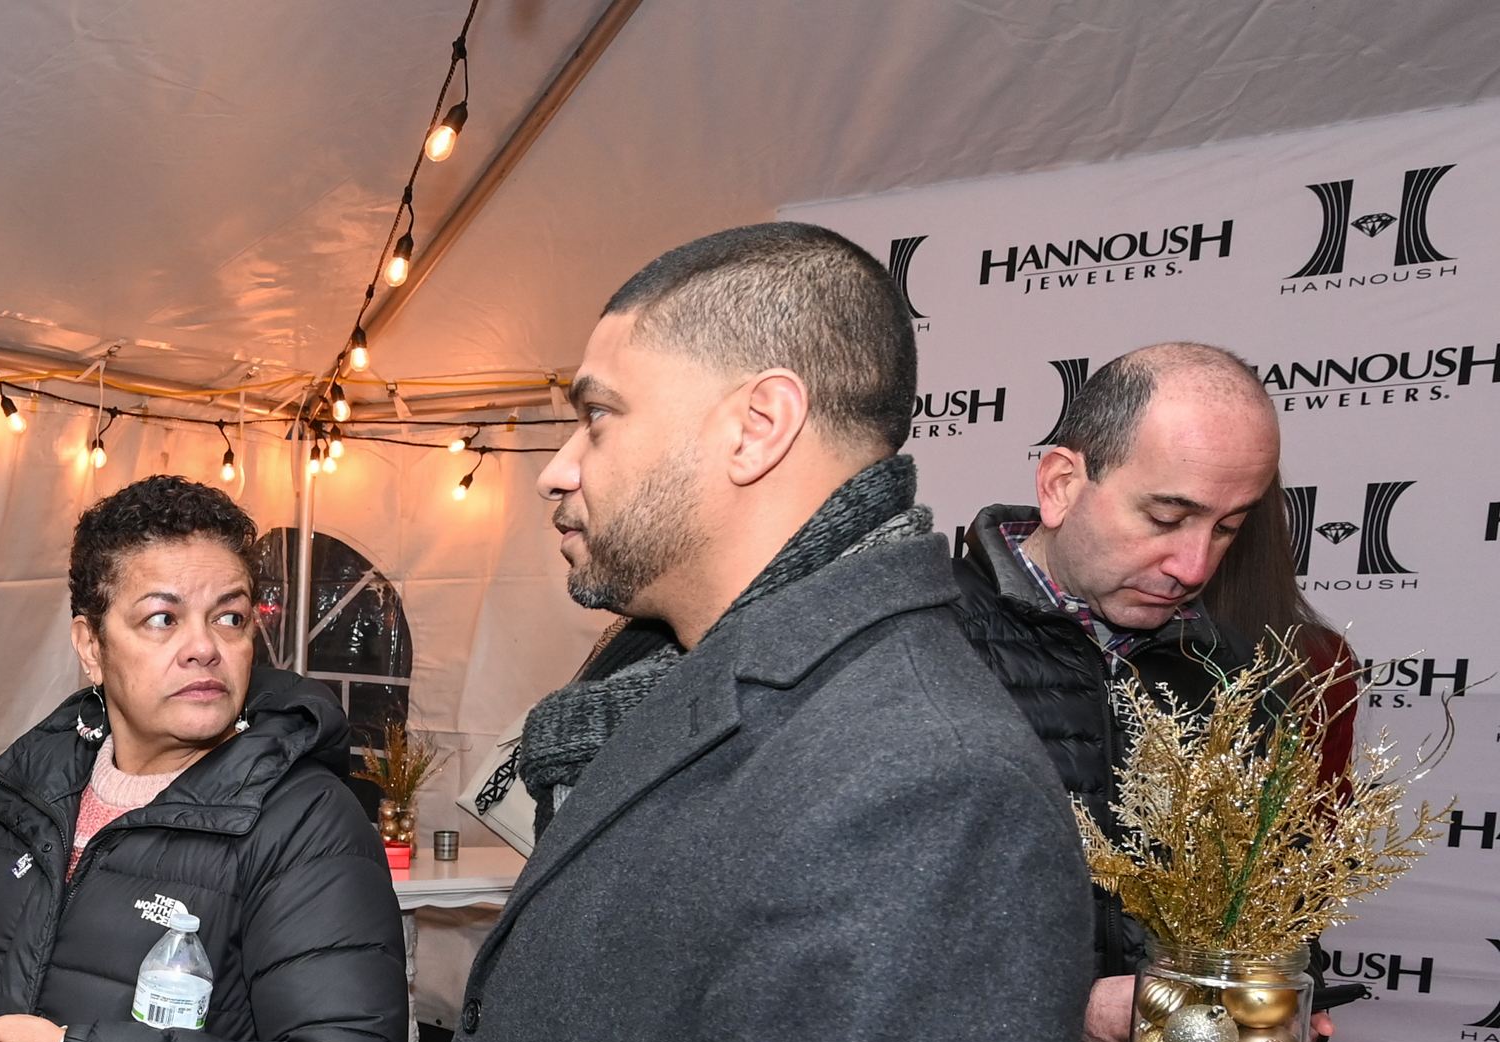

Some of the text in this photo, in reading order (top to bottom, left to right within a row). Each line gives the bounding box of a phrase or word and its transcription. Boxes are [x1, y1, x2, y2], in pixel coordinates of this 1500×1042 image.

[980, 219, 1234, 285] HANNOUSH
[1280, 265, 1457, 295] HANNOUSH
[1250, 342, 1500, 390] ANNOUSH
[1284, 385, 1450, 412] EWELERS.
[1298, 579, 1419, 591] NOUSH
[134, 899, 172, 918] NORTH
[154, 893, 176, 909] THE
[140, 910, 171, 928] FACE
